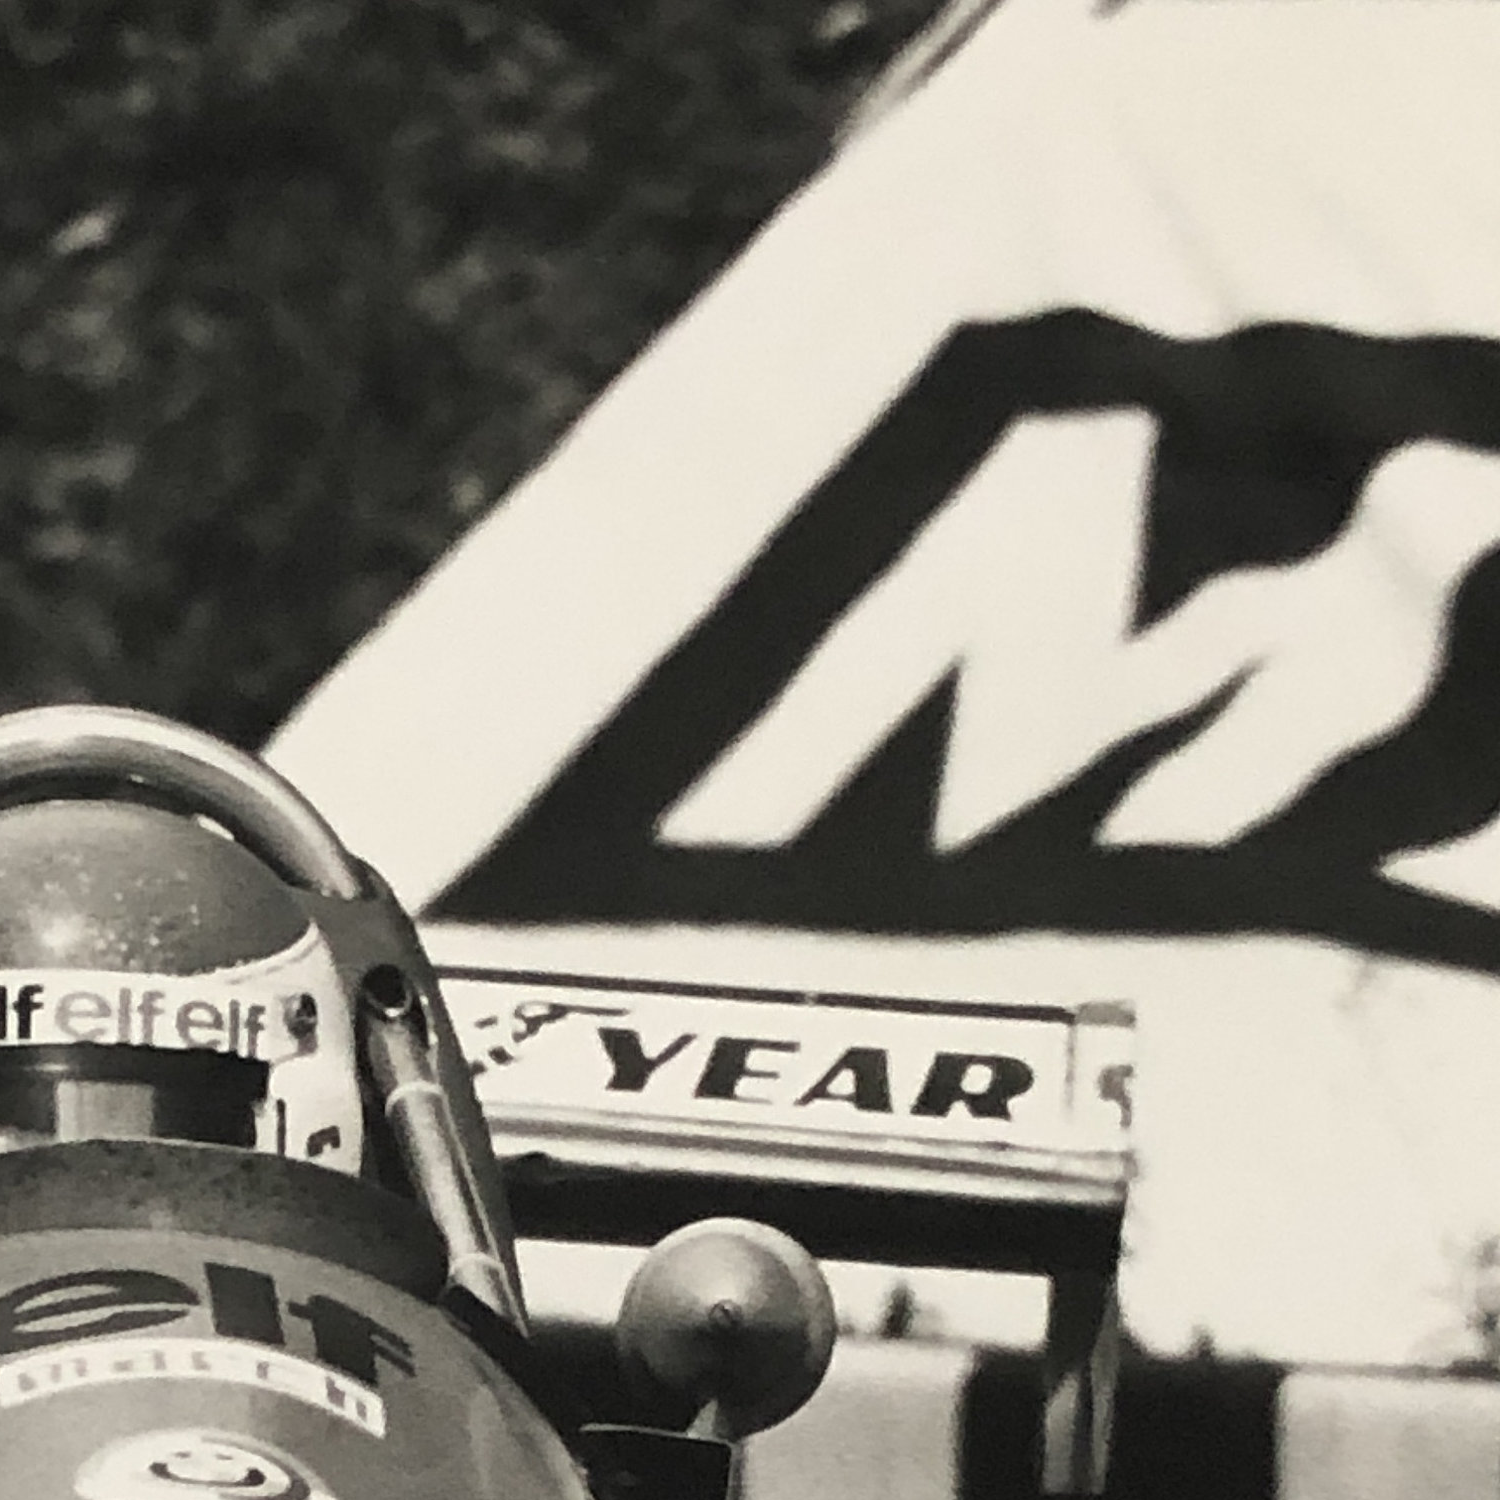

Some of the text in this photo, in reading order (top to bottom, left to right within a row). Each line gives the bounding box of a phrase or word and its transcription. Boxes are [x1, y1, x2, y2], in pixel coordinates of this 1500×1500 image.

[54, 987, 166, 1045] elf
[174, 996, 266, 1058] elf
[597, 1026, 1035, 1122] YEAR
